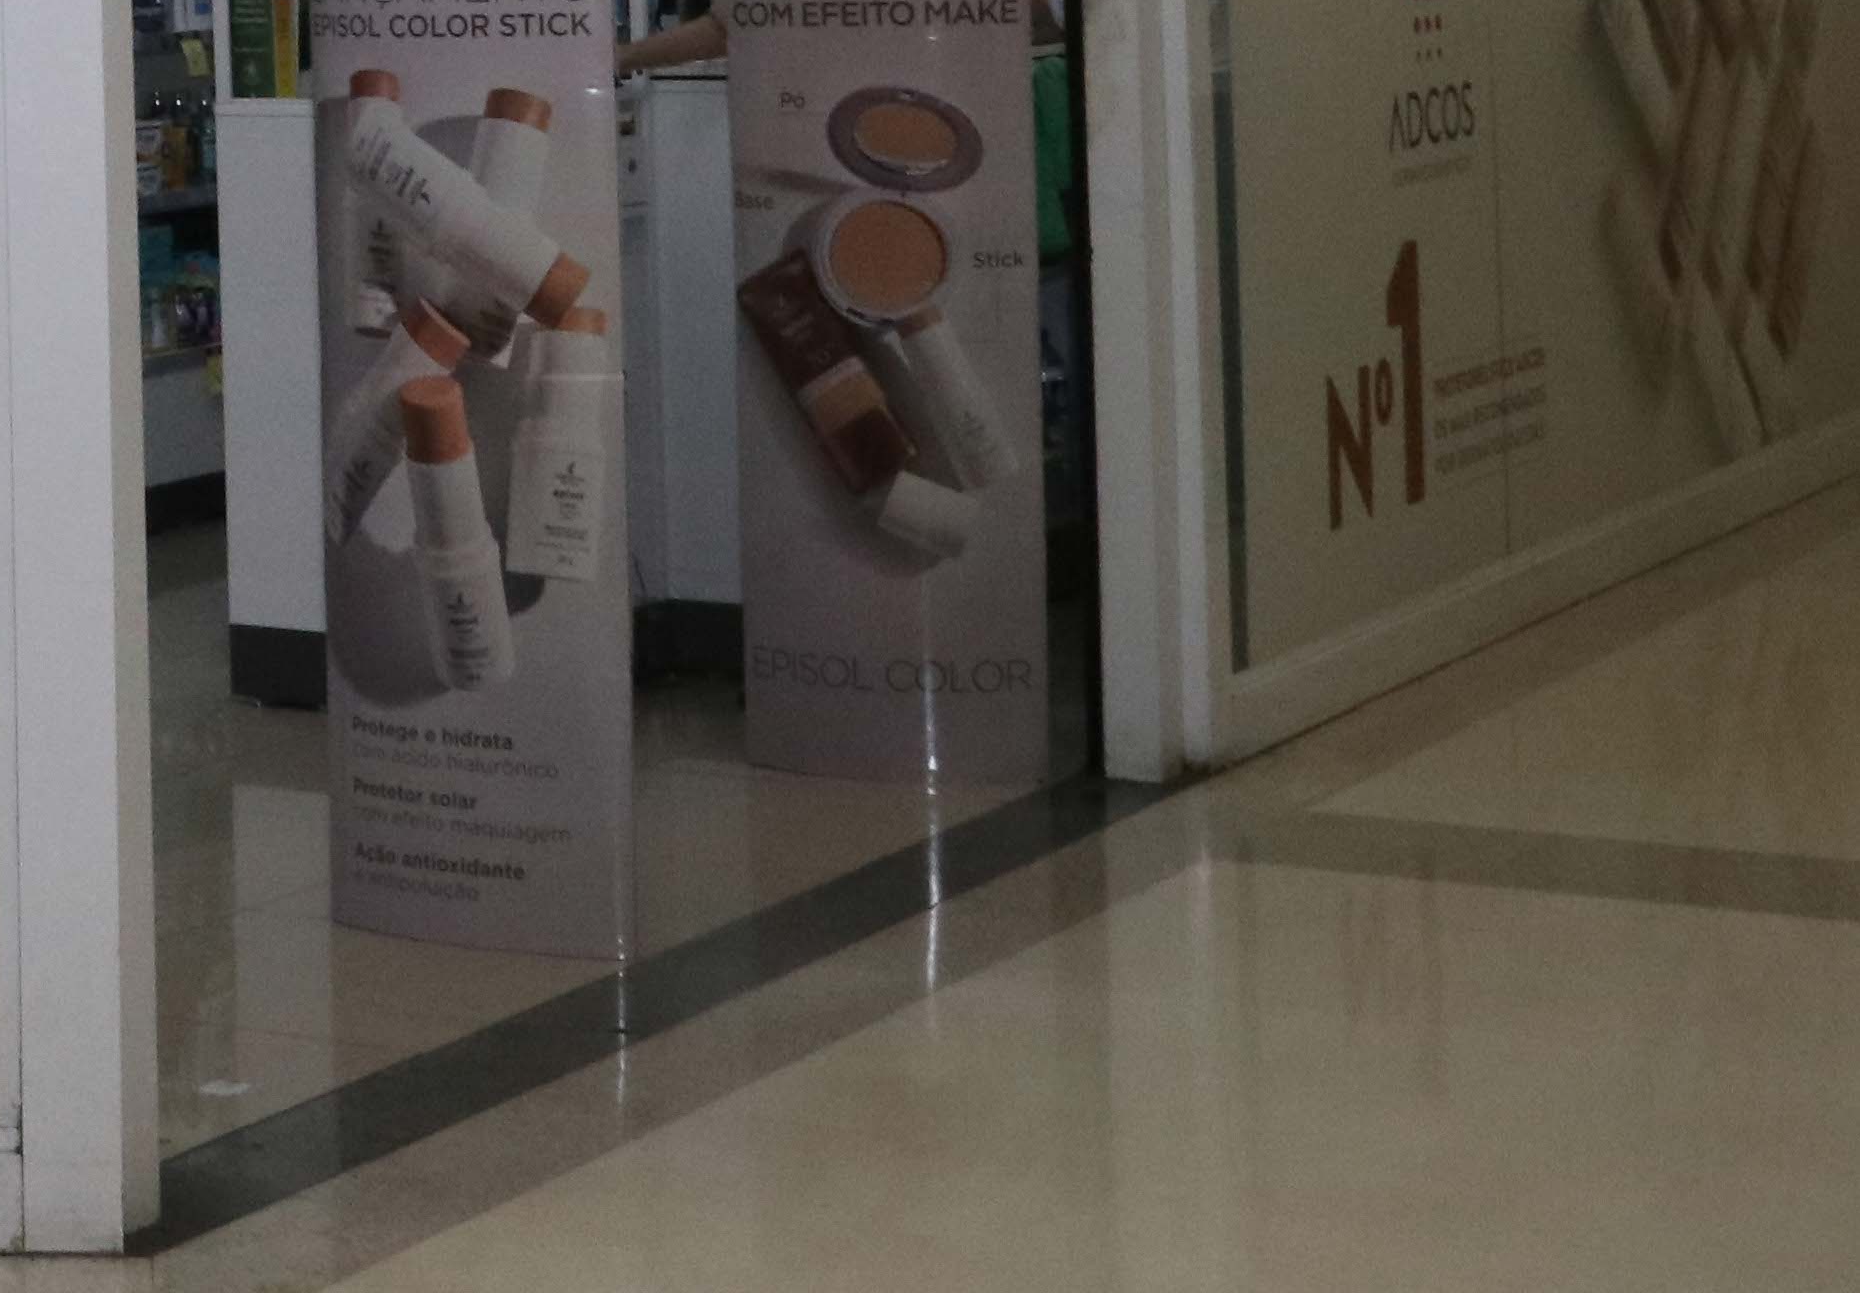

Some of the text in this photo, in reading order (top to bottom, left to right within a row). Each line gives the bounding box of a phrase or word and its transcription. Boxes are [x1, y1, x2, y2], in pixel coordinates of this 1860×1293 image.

[312, 11, 594, 40] EPISOL COLOR STICK
[732, 1, 795, 28] COM
[802, 0, 916, 28] EFEITO
[1387, 79, 1476, 154] ADCOS
[972, 248, 1025, 270] Stick
[750, 642, 1034, 695] EPISOL COLOR
[351, 713, 420, 743] Protege
[440, 725, 515, 752] hidrata
[351, 774, 479, 812] Protetor solar
[353, 839, 527, 882] Ação antioxidante
